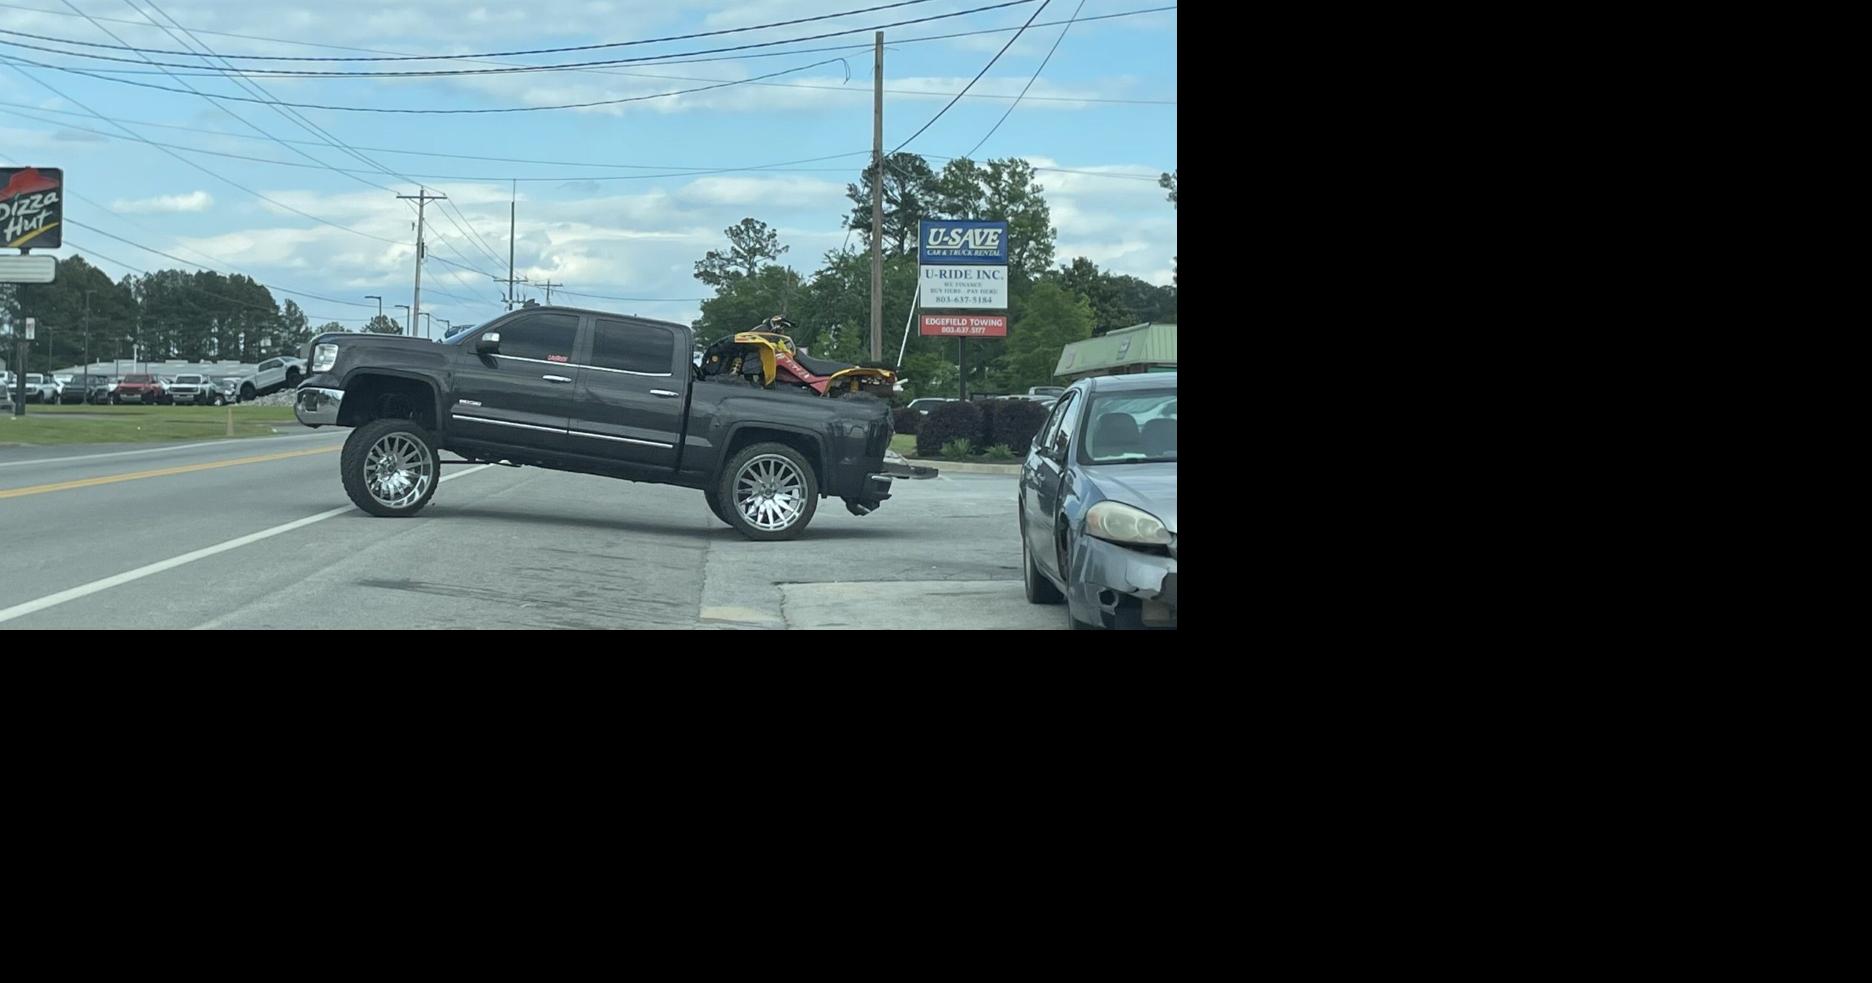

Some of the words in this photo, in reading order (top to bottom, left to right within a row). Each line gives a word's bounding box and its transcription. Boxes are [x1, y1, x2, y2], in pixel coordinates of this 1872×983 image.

[3, 209, 53, 242] Hut
[926, 228, 1002, 249] U-SAVE
[925, 269, 973, 279] U-RIDE
[977, 270, 1004, 280] INC.
